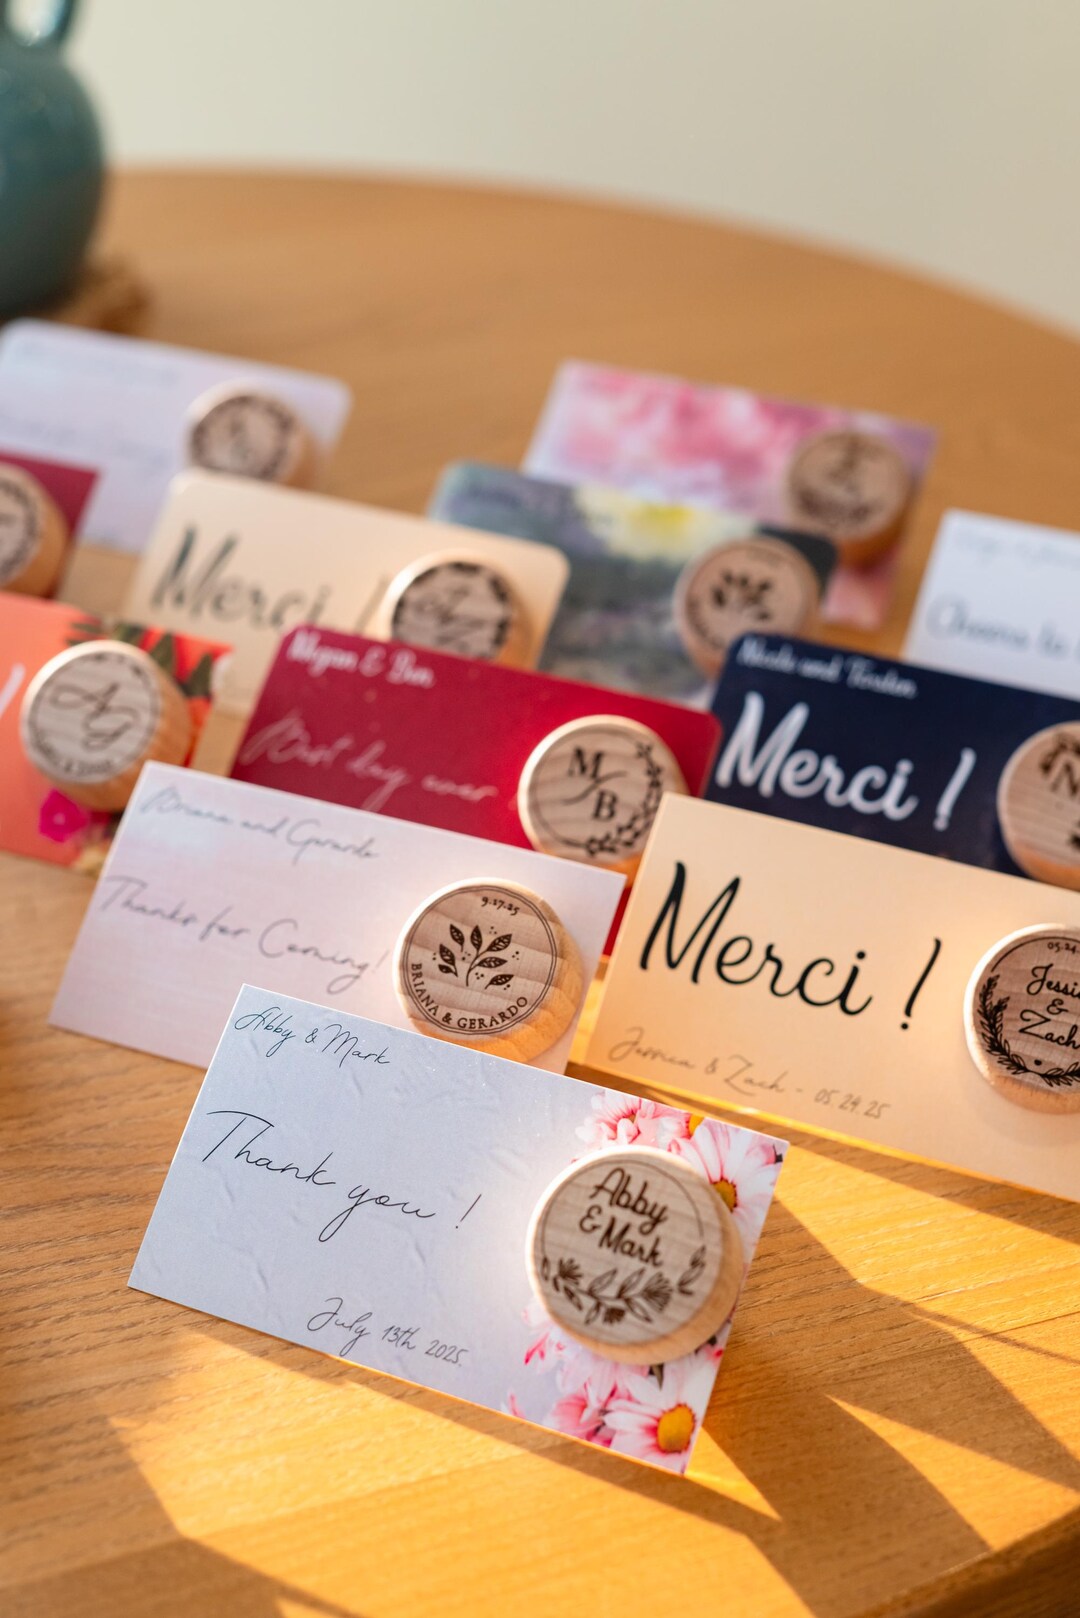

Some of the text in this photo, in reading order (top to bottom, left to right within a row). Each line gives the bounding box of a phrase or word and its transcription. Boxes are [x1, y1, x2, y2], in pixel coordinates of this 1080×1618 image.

[149, 523, 331, 631] Merci
[798, 654, 843, 682] and
[568, 745, 604, 779] M
[714, 692, 976, 831] Merci !
[240, 817, 287, 837] and
[592, 788, 619, 821] B
[101, 875, 198, 926] Thanks
[199, 906, 250, 941] for
[481, 896, 520, 916] 9.17.25
[639, 860, 943, 1031] Merci !
[411, 963, 528, 1030] BRIANA & GERARDO
[1026, 963, 1080, 999] Jessi
[1046, 998, 1069, 1015] &
[234, 1006, 391, 1068] Abby & Mark
[1019, 1009, 1080, 1050] Zach
[703, 1056, 718, 1075] &
[722, 1054, 788, 1097] Zach
[202, 1110, 482, 1242] Thank you !
[589, 1167, 668, 1236] Abby
[579, 1204, 663, 1268] & Mark
[307, 1297, 373, 1357] July
[381, 1324, 421, 1350] 13th
